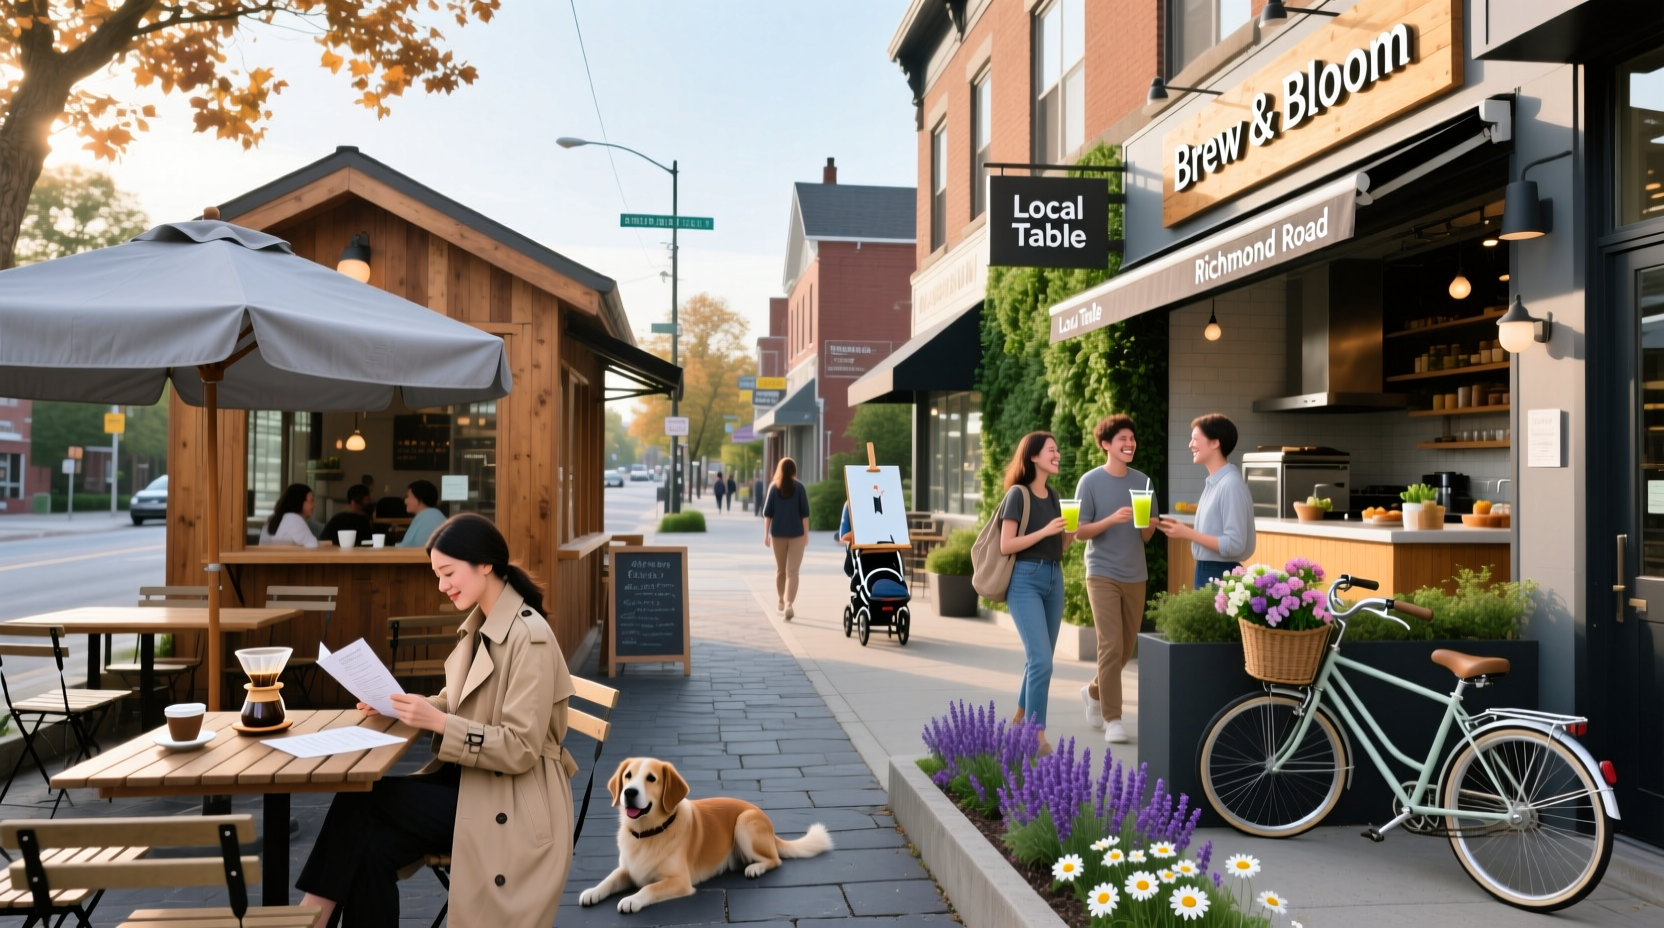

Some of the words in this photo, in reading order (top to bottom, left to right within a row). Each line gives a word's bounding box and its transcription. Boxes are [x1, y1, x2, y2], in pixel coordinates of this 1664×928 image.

[1174, 120, 1243, 193] Brew
[1249, 91, 1275, 147] &
[1282, 23, 1411, 132] Bloom
[1013, 194, 1084, 220] Local
[1011, 222, 1087, 249] Table
[1195, 228, 1276, 285] Richmond
[1282, 206, 1329, 253] Road
